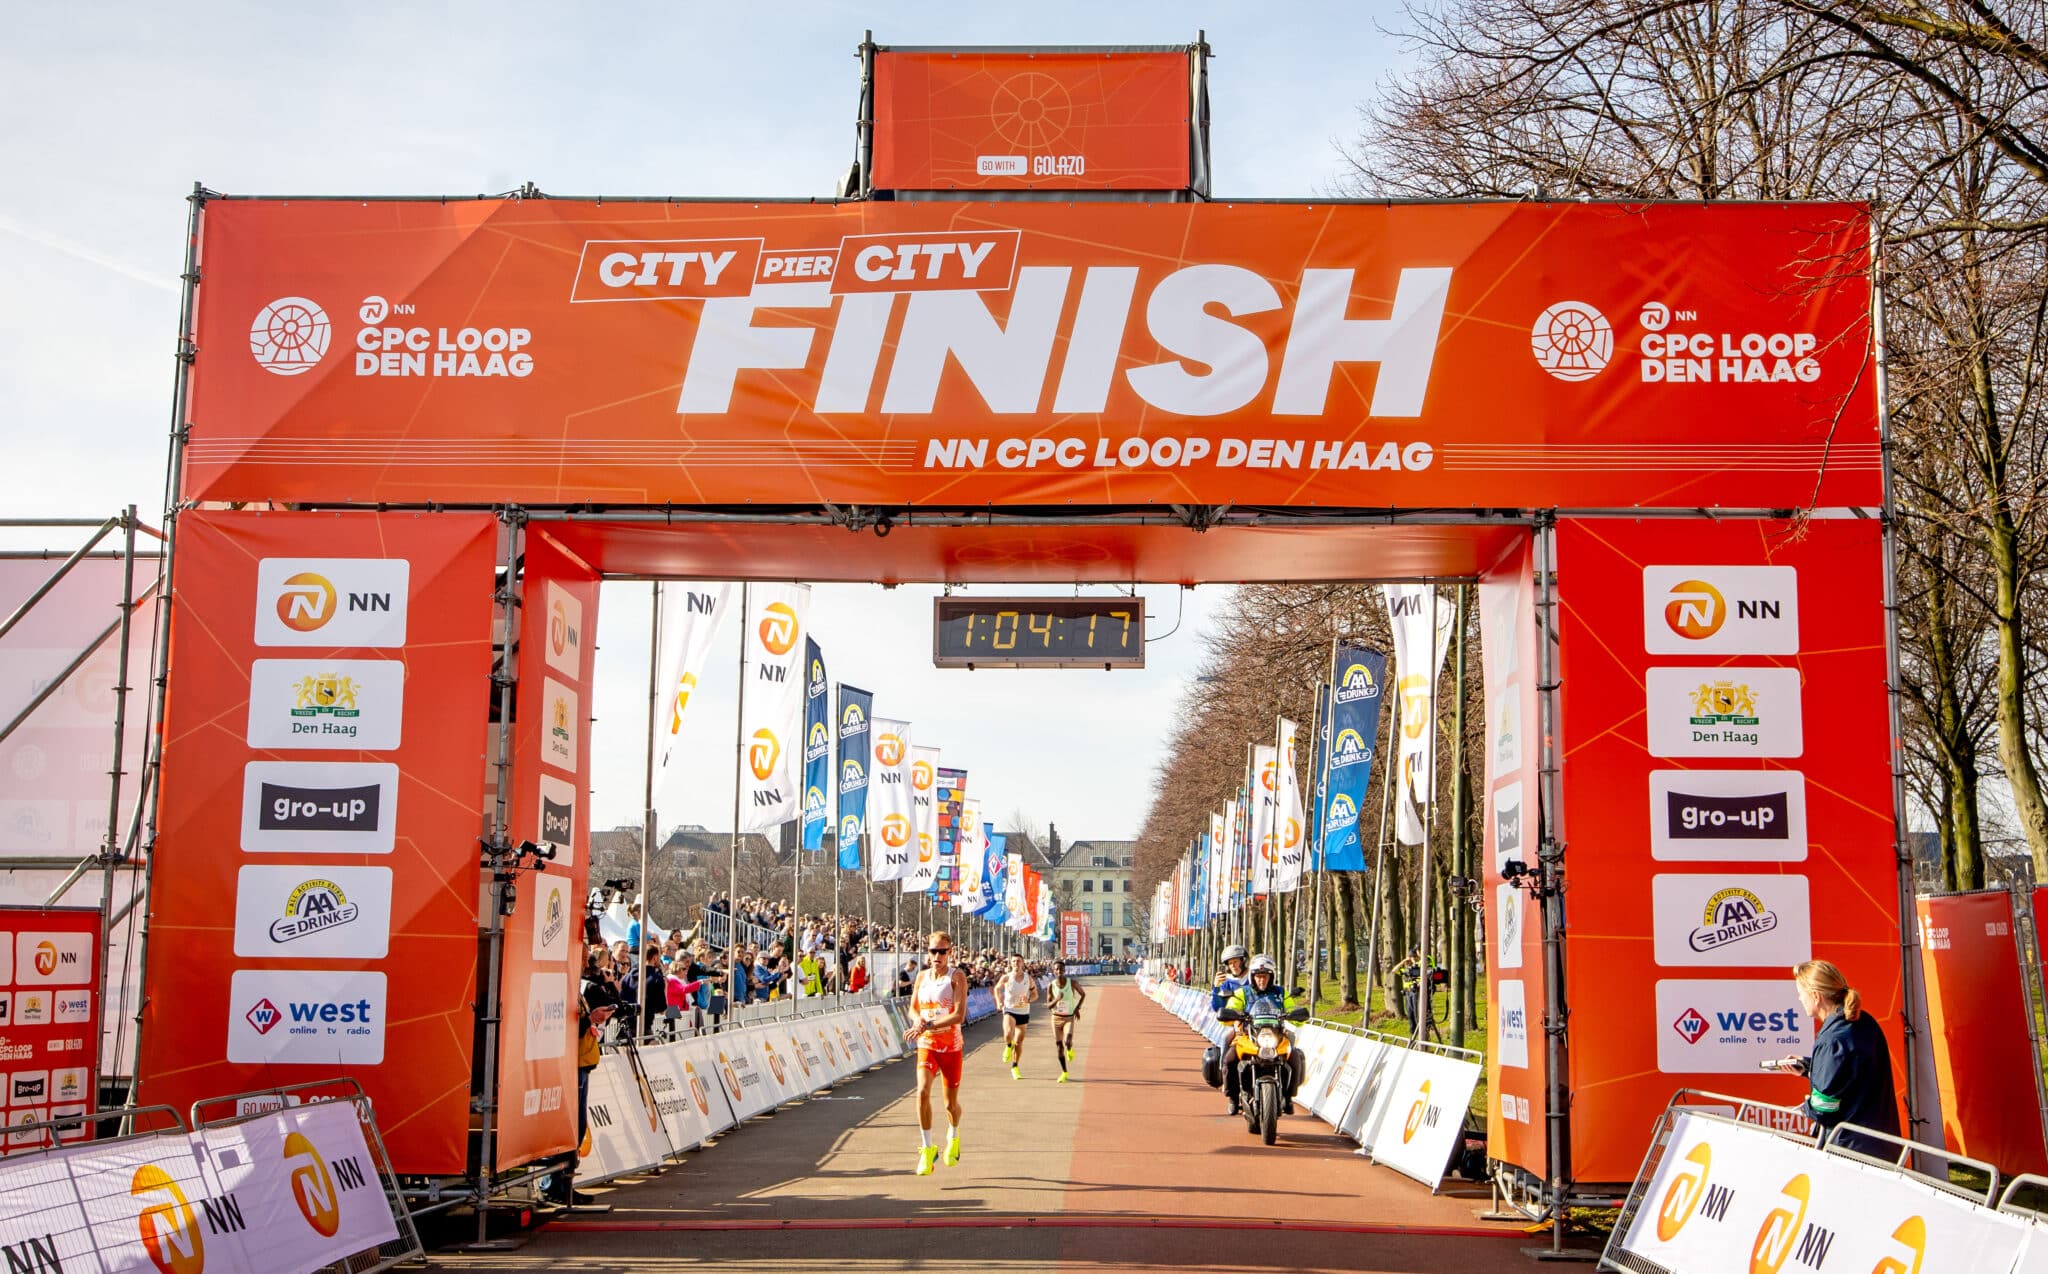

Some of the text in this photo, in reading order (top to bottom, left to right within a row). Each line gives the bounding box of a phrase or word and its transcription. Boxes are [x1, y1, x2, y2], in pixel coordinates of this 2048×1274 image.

[982, 156, 1085, 175] GO WITH GOLAZO
[599, 242, 996, 287] CITY PIER CITY
[393, 304, 416, 315] NN
[1675, 310, 1697, 321] NN
[356, 327, 532, 352] CPC LOOP
[676, 264, 1454, 417] FINISH
[1640, 333, 1816, 358] CPC LOOP
[355, 352, 534, 377] DEN HAAG
[1641, 357, 1822, 383] DEN HAAG
[923, 437, 1434, 472] NN CPC LOOP DEN HAAG
[348, 593, 391, 612] NN
[686, 591, 717, 616] NN
[1737, 600, 1781, 619] NN
[567, 624, 578, 648] NN
[965, 611, 1130, 650] 1:04:17
[759, 663, 787, 683] NN
[1350, 674, 1366, 689] AA
[1346, 688, 1369, 699] DRINK
[292, 722, 357, 737] Den Haag
[1692, 731, 1758, 746] Den Haag
[1343, 738, 1358, 754] AA
[845, 767, 860, 782] AA
[881, 773, 901, 784] NN
[753, 788, 782, 807] NN
[914, 796, 929, 806] NN
[274, 798, 366, 822] gro-up
[1333, 802, 1350, 819] AA
[1681, 806, 1775, 829] gro-up
[546, 811, 569, 838] gro-up
[886, 853, 909, 865] NN
[1282, 852, 1301, 866] NN
[303, 893, 336, 918] AA
[1722, 901, 1754, 927] AA
[297, 910, 343, 933] DRINK
[1716, 919, 1762, 942] DRINK
[61, 952, 77, 963] NN
[68, 1000, 87, 1009] west
[289, 999, 371, 1023] west
[543, 1001, 564, 1020] west
[1505, 1008, 1523, 1029] west
[1716, 1008, 1799, 1032] west
[289, 1026, 371, 1035] online tv radio
[1719, 1035, 1800, 1044] online tv radio
[18, 1084, 41, 1094] gro-up
[243, 1102, 257, 1115] GO
[589, 1103, 613, 1128] NN
[1423, 1104, 1442, 1129] NN
[332, 1156, 366, 1192] NN
[199, 1193, 247, 1234] NN
[1700, 1184, 1736, 1222] NN
[1, 1233, 65, 1274] NN
[1796, 1223, 1835, 1271] NN
